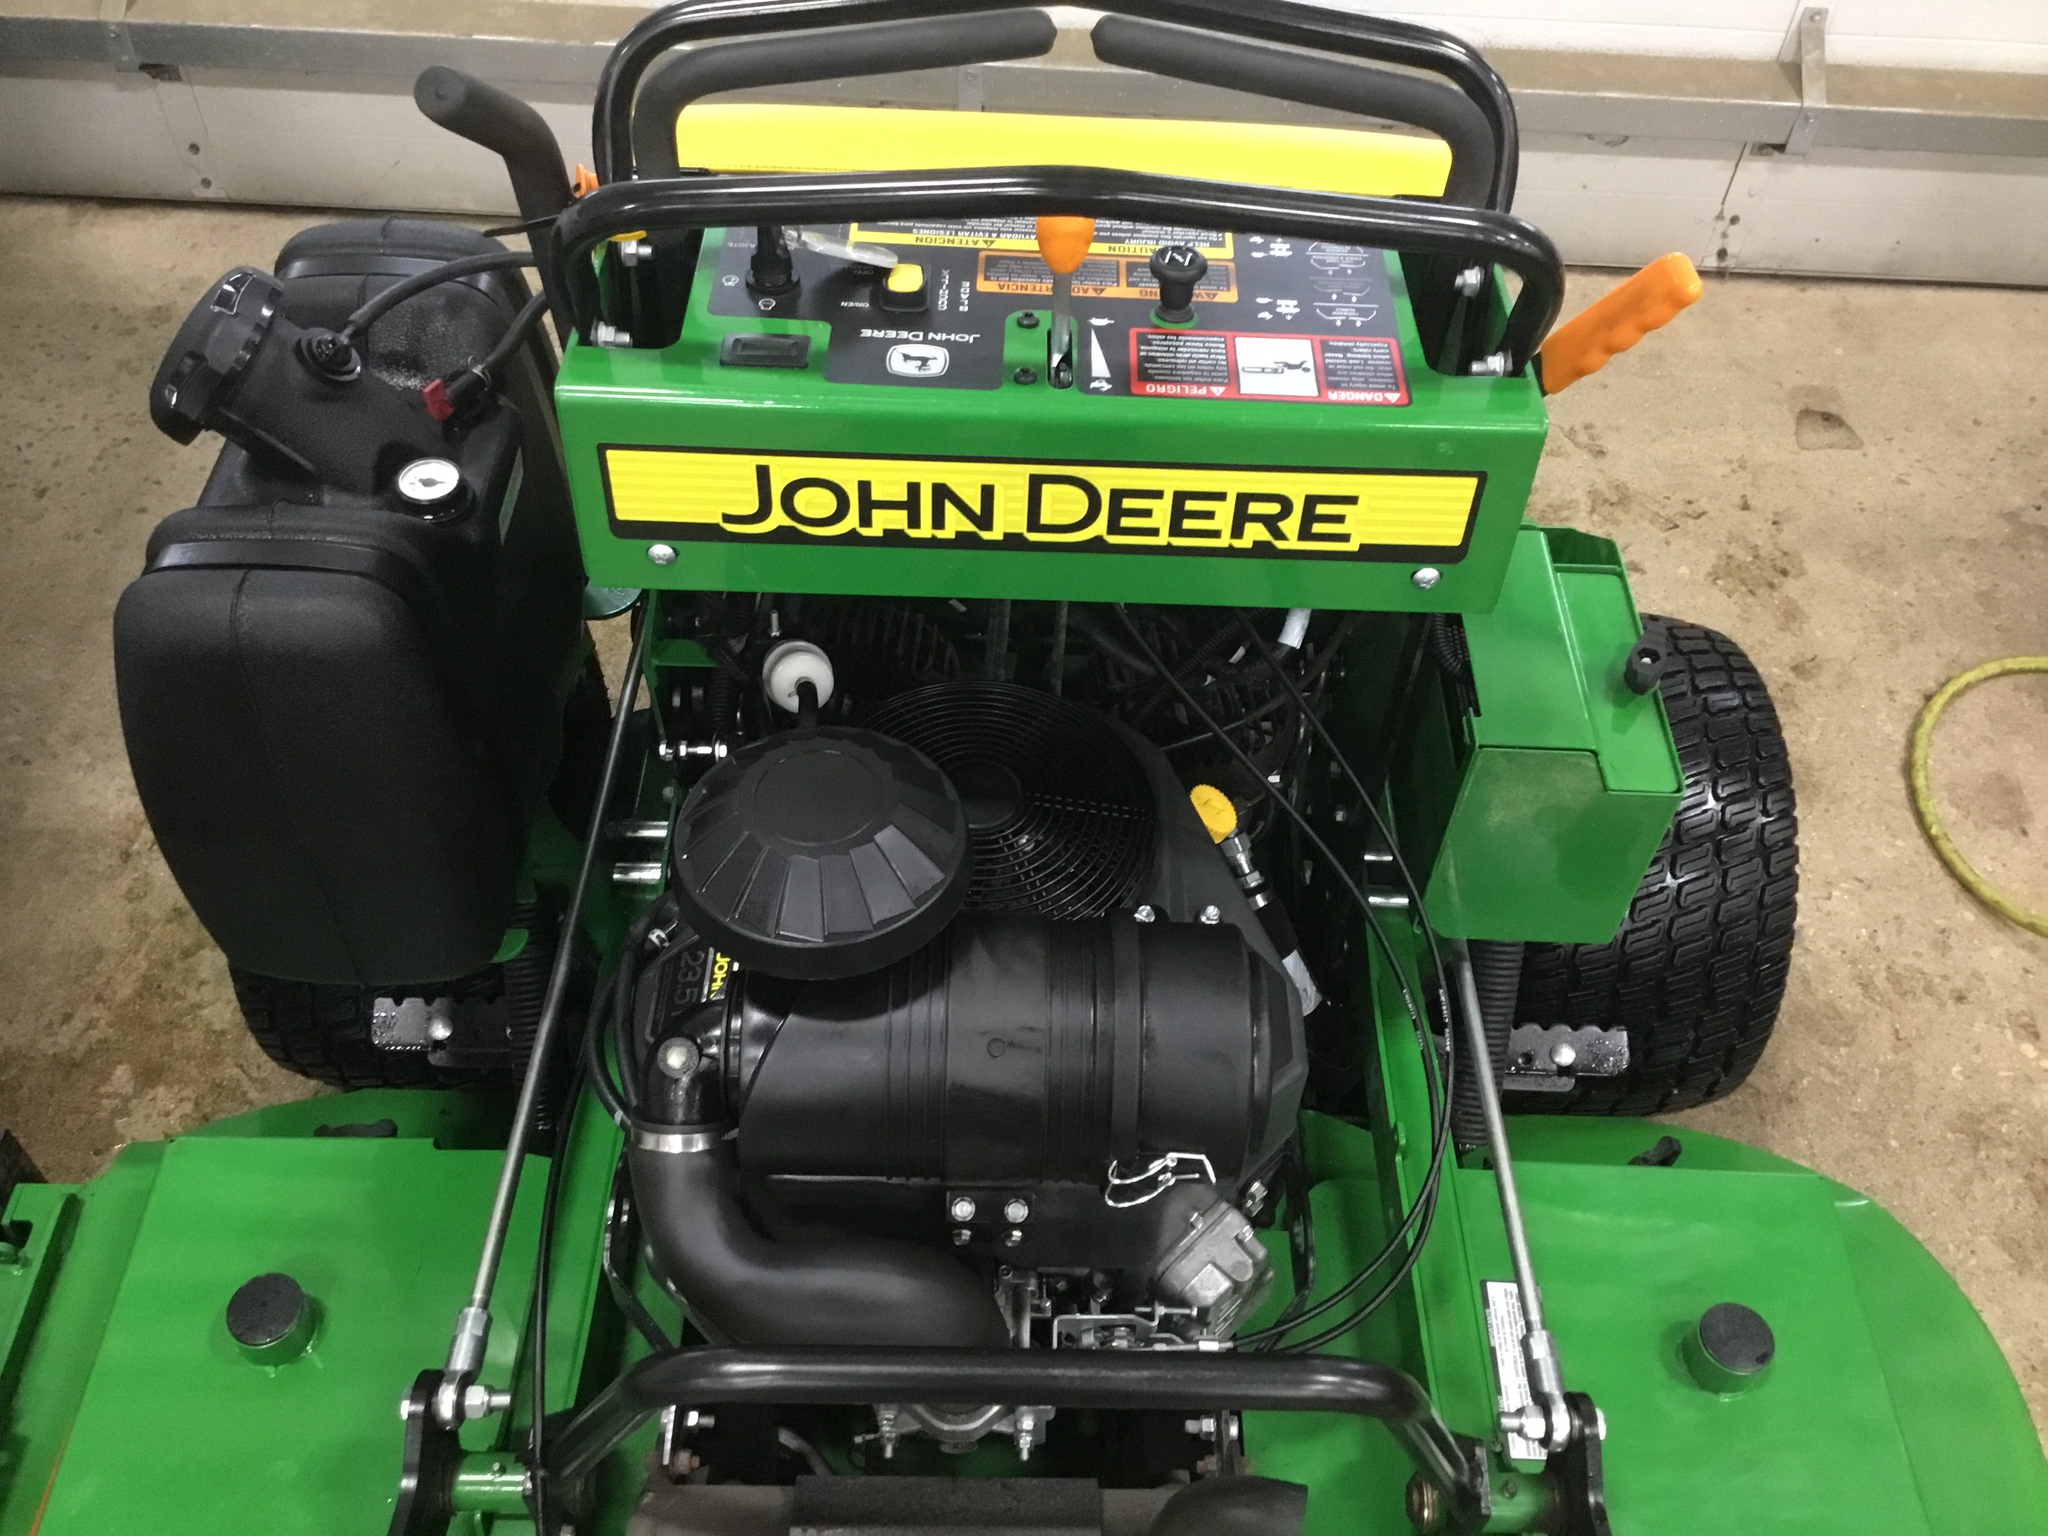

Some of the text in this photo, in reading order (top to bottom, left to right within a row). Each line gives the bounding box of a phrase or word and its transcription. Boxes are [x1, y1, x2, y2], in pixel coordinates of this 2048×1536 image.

[912, 228, 955, 236] LESIONES
[957, 230, 988, 238] EVITAR
[915, 236, 979, 246] ATENCION
[1108, 245, 1157, 254] AUTION
[860, 328, 980, 344] JOHN DEERE
[1145, 384, 1207, 394] PELIGRO
[1328, 391, 1383, 402] DANGER
[722, 464, 1358, 543] JOHN DEERE
